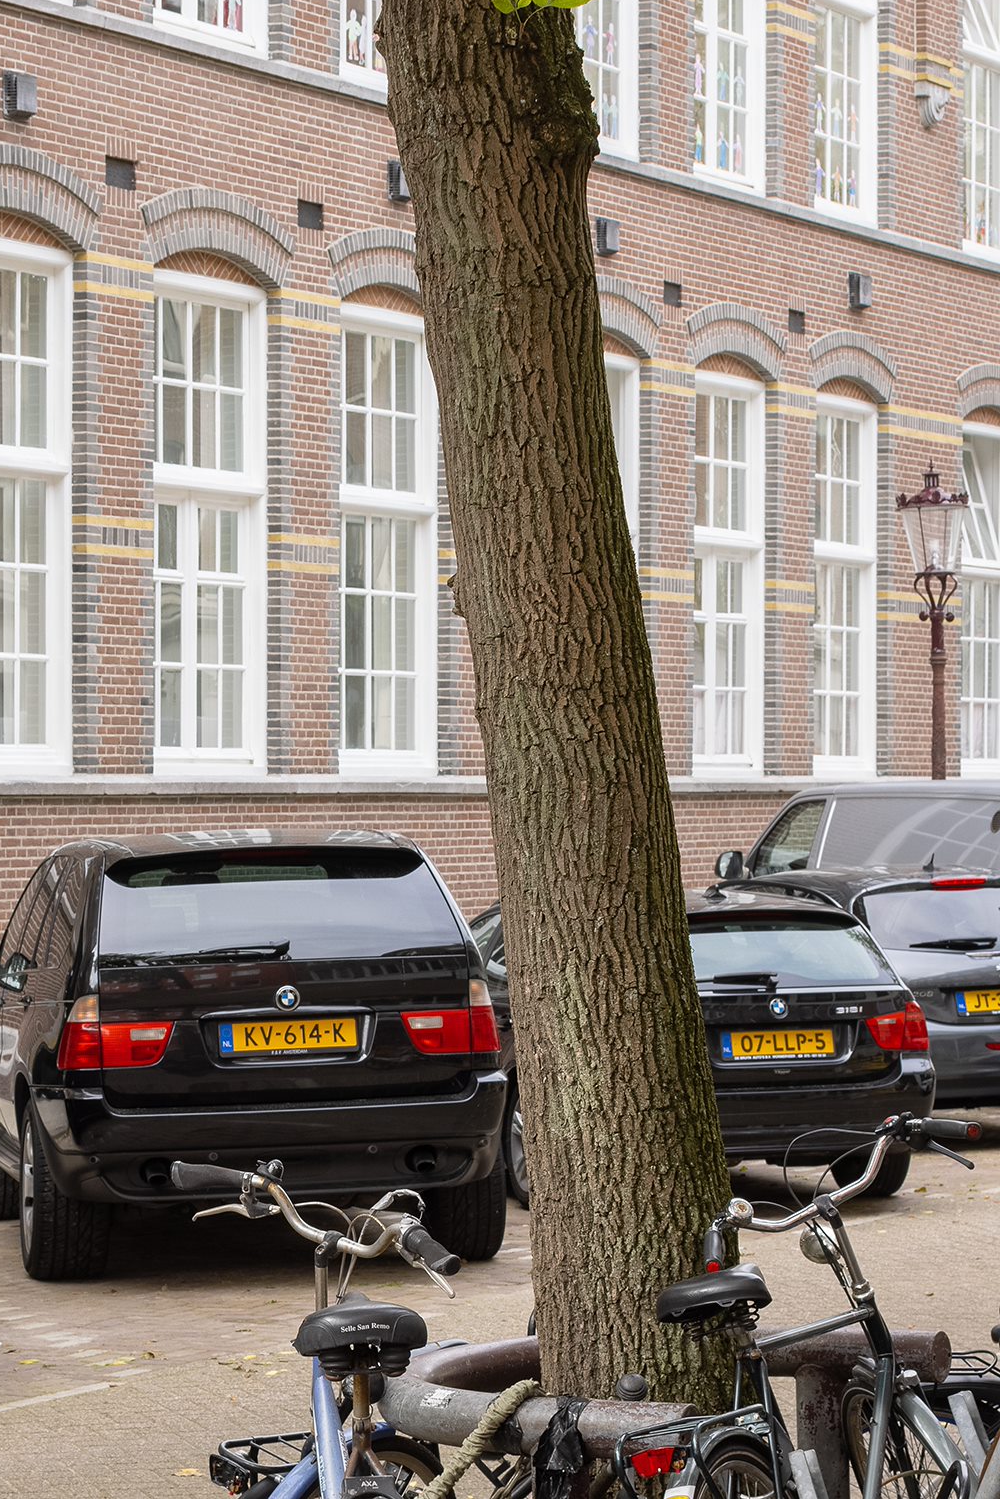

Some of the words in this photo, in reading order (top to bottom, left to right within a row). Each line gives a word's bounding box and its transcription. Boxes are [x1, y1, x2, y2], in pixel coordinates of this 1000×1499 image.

[974, 992, 1000, 1009] JT-
[244, 1022, 346, 1047] KV-614-K
[740, 1033, 826, 1053] 07-LLP-5
[222, 1040, 232, 1048] NL
[340, 1325, 356, 1333] Selle
[357, 1323, 370, 1331] San
[371, 1322, 390, 1330] Remo
